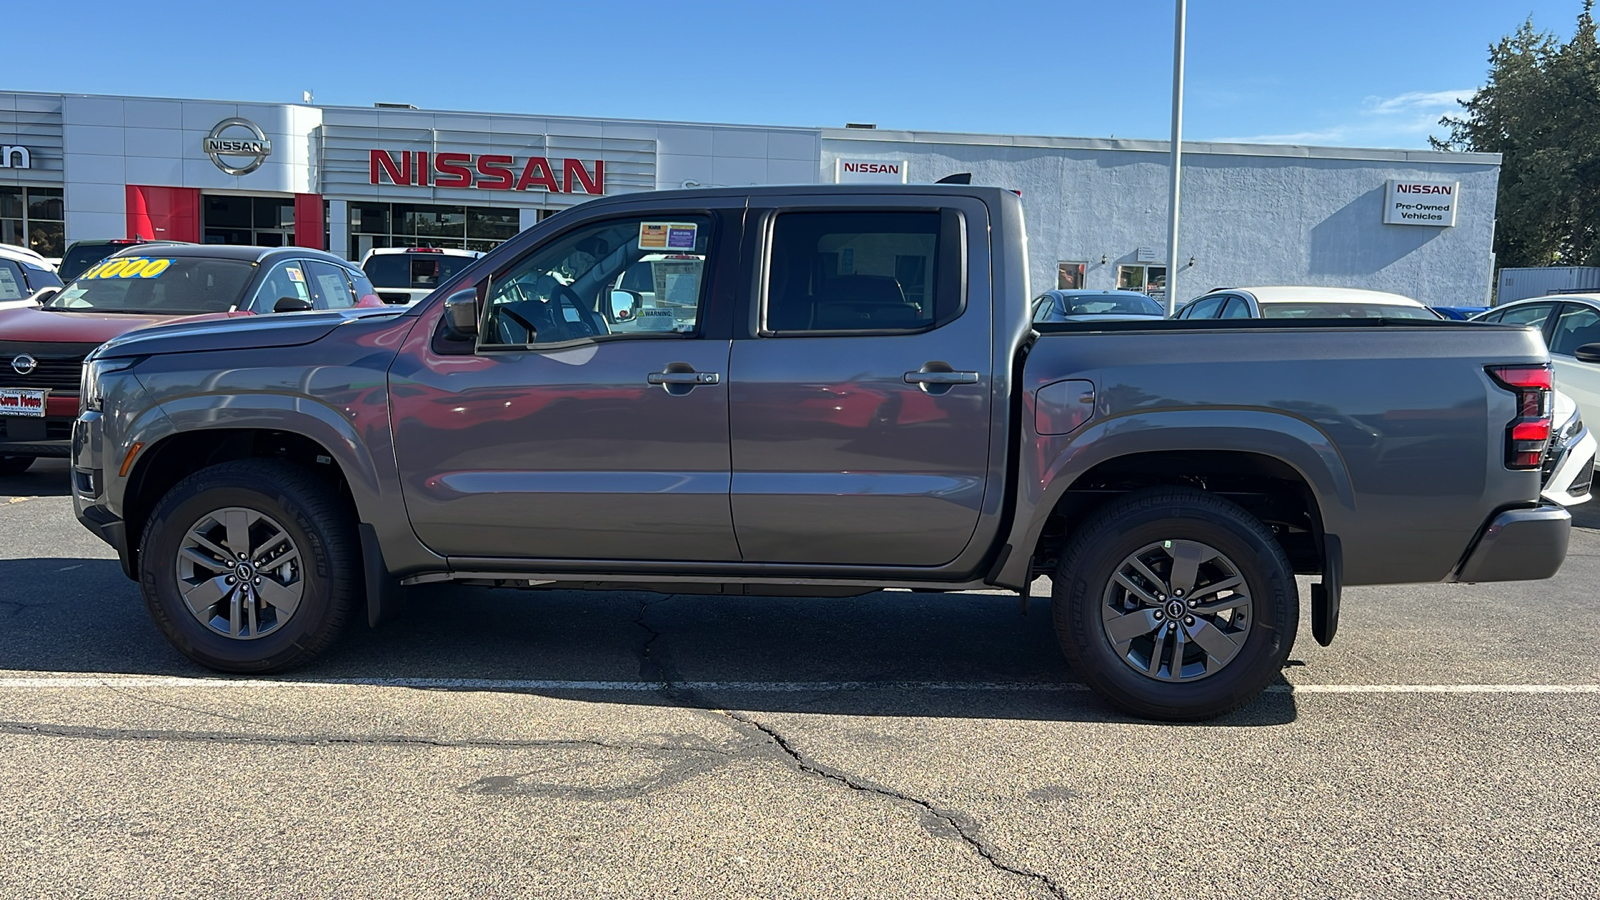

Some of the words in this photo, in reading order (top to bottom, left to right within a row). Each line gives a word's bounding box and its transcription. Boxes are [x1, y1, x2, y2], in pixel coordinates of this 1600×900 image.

[209, 140, 263, 152] NISSAN
[369, 149, 604, 196] NISSAN
[844, 162, 899, 174] NISSAN
[1397, 184, 1452, 195] NISSAN
[1395, 202, 1450, 212] Pre-Owned
[1401, 212, 1443, 220] Vehicles
